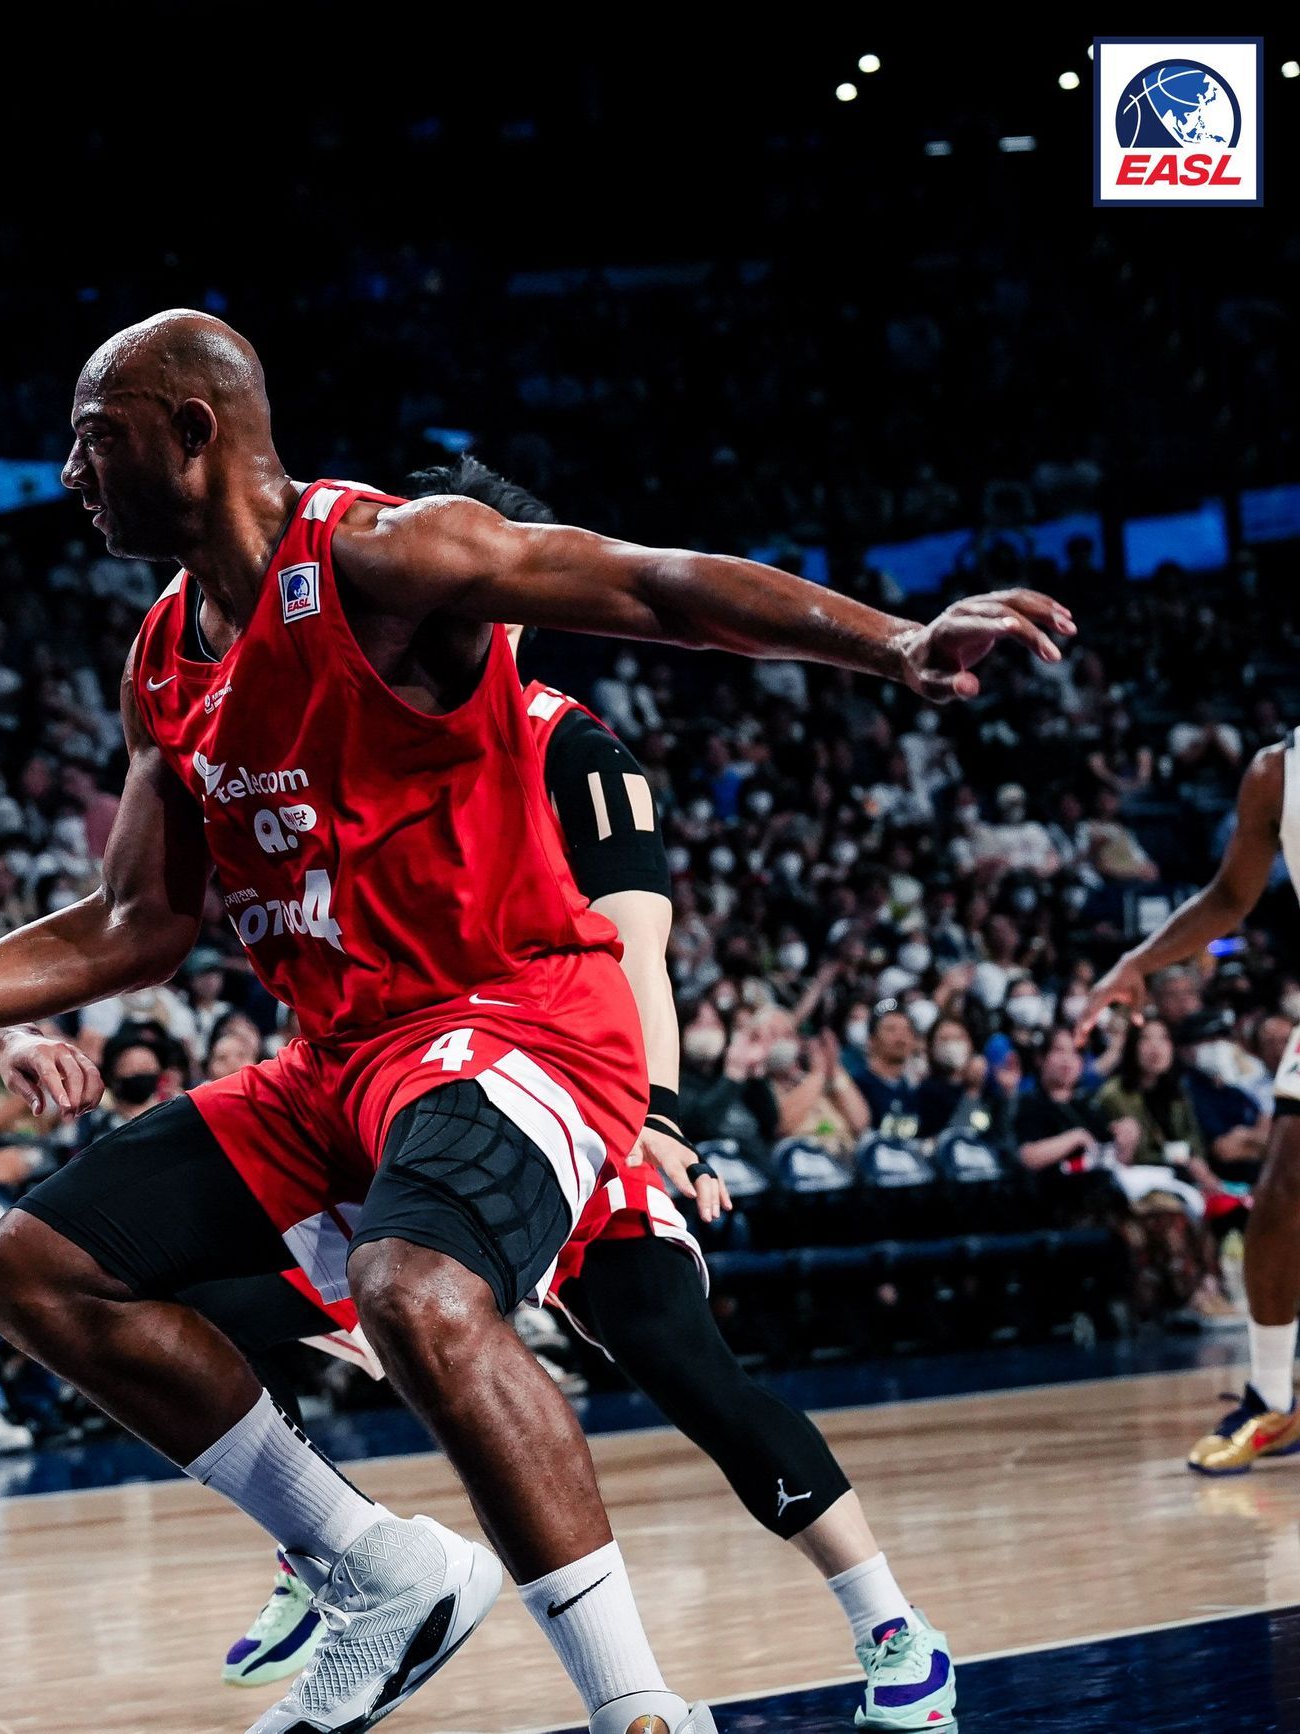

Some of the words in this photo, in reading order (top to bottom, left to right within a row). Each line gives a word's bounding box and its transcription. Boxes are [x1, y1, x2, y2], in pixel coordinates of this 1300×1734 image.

[287, 597, 311, 613] EASL
[214, 766, 310, 804] telecom
[227, 899, 309, 948] 0700
[302, 868, 347, 955] 4
[420, 1028, 474, 1072] 4
